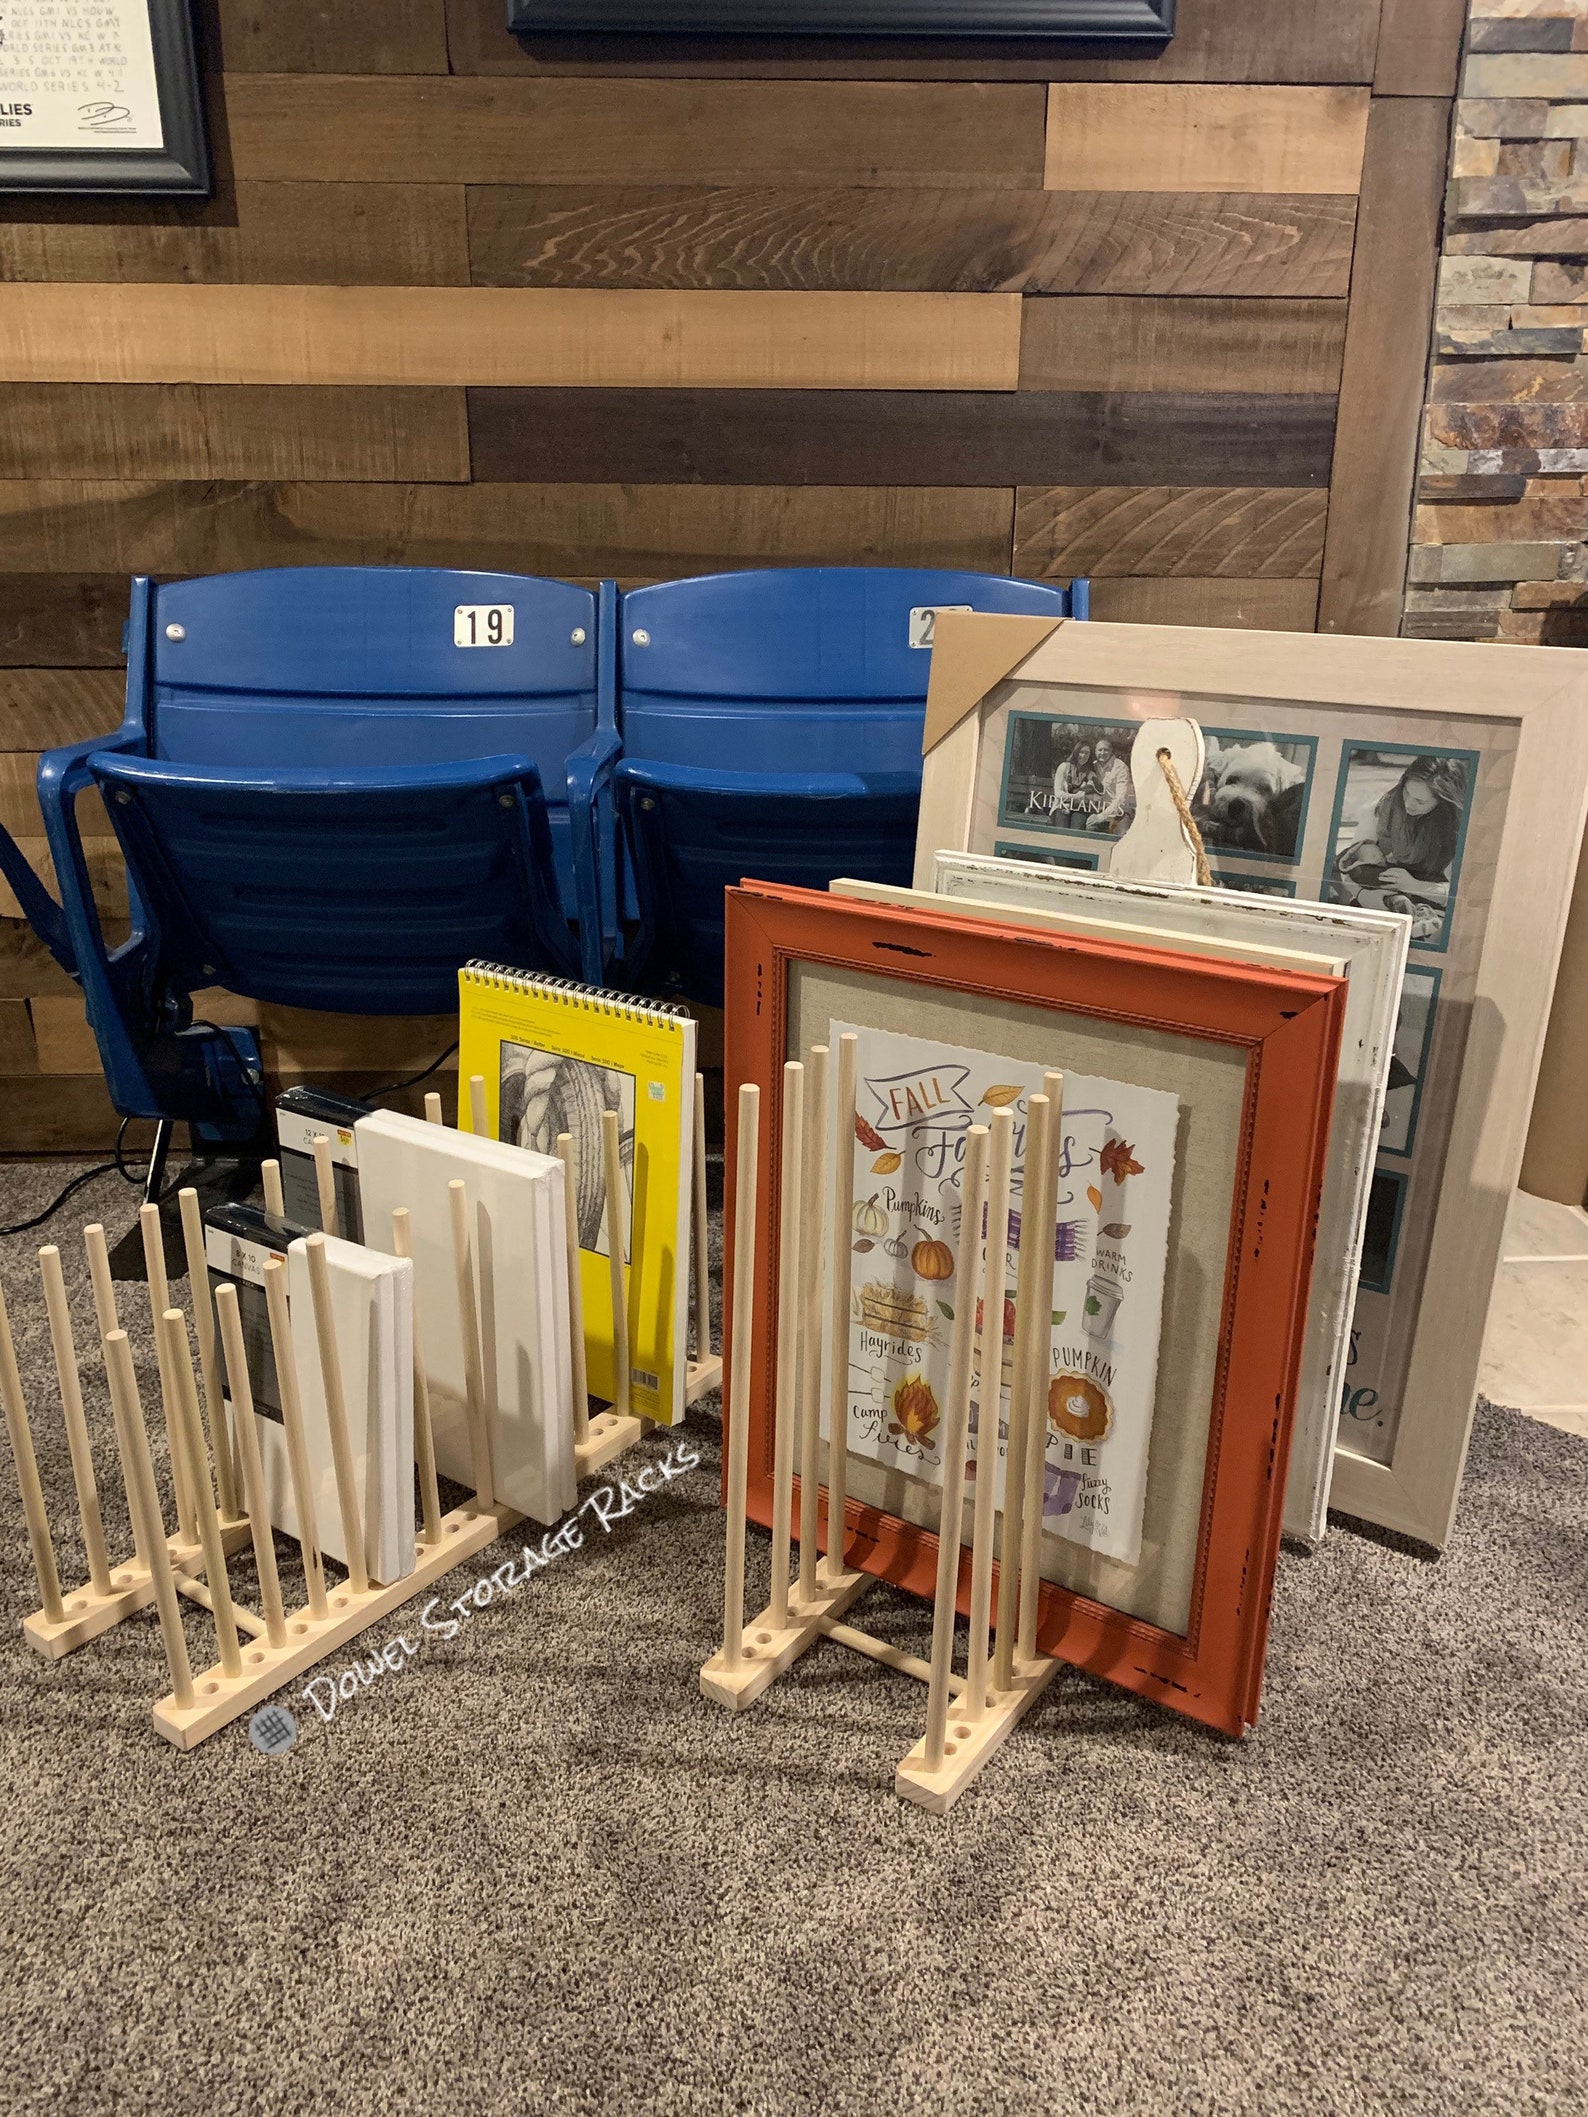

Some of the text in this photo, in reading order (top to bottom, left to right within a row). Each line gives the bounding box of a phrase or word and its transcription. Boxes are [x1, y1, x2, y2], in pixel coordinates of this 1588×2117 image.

[0, 103, 33, 116] LIES
[0, 118, 21, 127] RIES
[467, 608, 503, 645] 19
[919, 609, 936, 646] 2
[889, 1077, 951, 1121] FALL
[882, 1185, 945, 1226] Pumpkins
[1096, 1248, 1126, 1265] WARM
[860, 1331, 922, 1363] Hayrides
[1052, 1347, 1117, 1387] PUMPKIN
[853, 1405, 888, 1423] Camp
[1045, 1431, 1098, 1467] PIE
[1081, 1472, 1112, 1495] fuzzy
[1075, 1492, 1110, 1515] SOCKS
